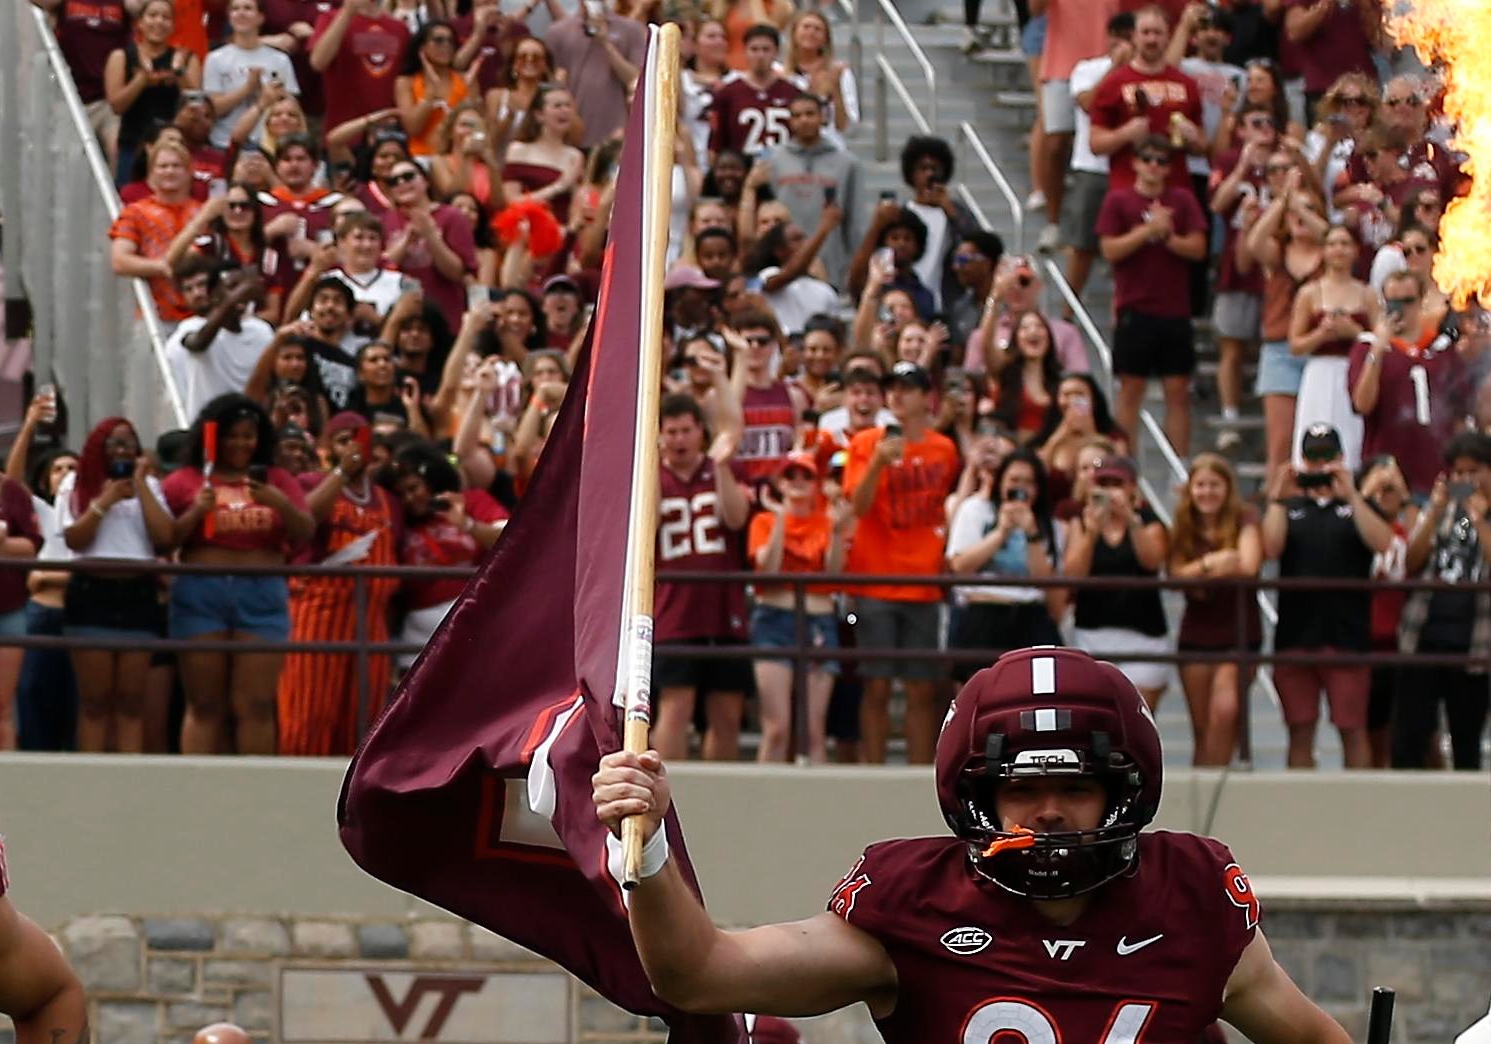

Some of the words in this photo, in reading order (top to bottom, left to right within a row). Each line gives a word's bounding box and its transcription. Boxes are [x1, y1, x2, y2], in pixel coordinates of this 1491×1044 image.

[737, 106, 791, 155] 25
[660, 492, 726, 561] 22
[1225, 863, 1259, 930] 9
[1042, 939, 1086, 960] VT
[363, 974, 488, 1040] VT
